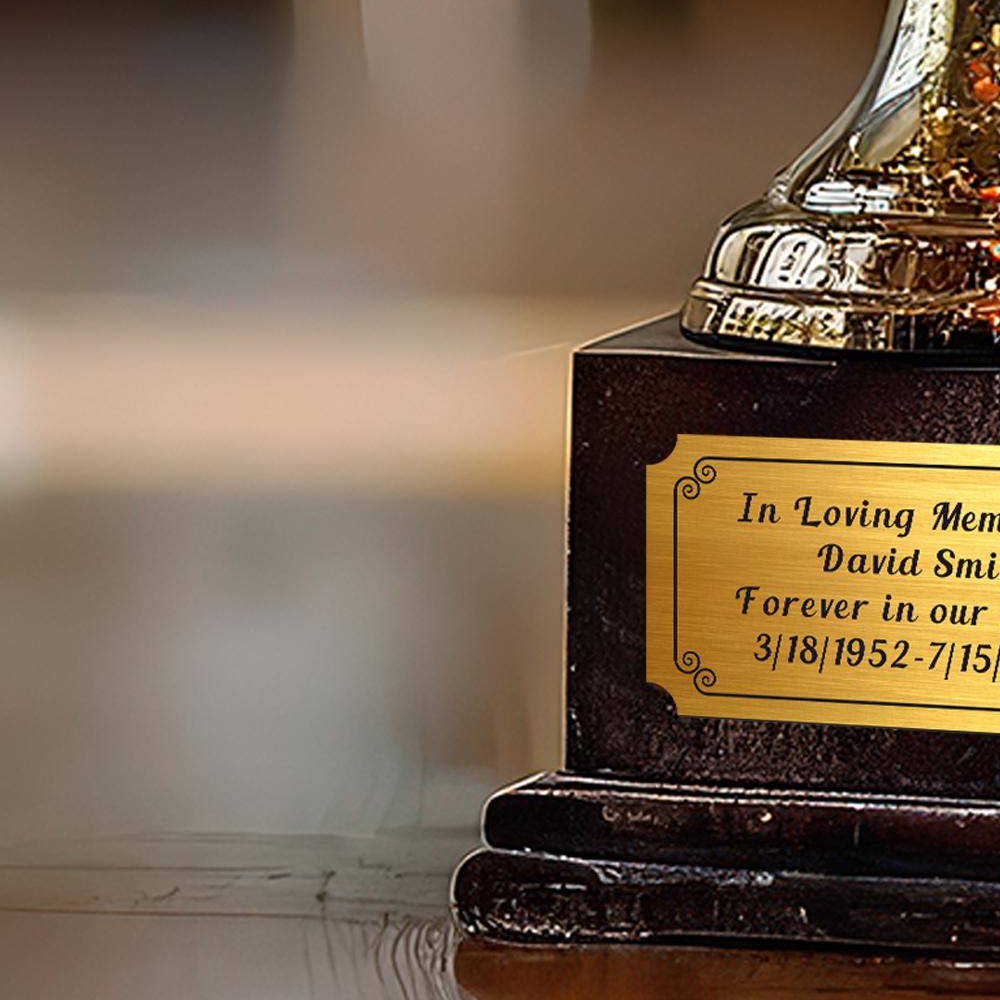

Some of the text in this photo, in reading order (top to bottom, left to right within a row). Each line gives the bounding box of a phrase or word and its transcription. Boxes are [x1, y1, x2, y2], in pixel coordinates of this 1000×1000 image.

[736, 492, 781, 524] In
[793, 495, 915, 538] Loving
[816, 543, 923, 578] David
[734, 585, 869, 621] Forever
[881, 593, 919, 623] in
[929, 603, 988, 626] our
